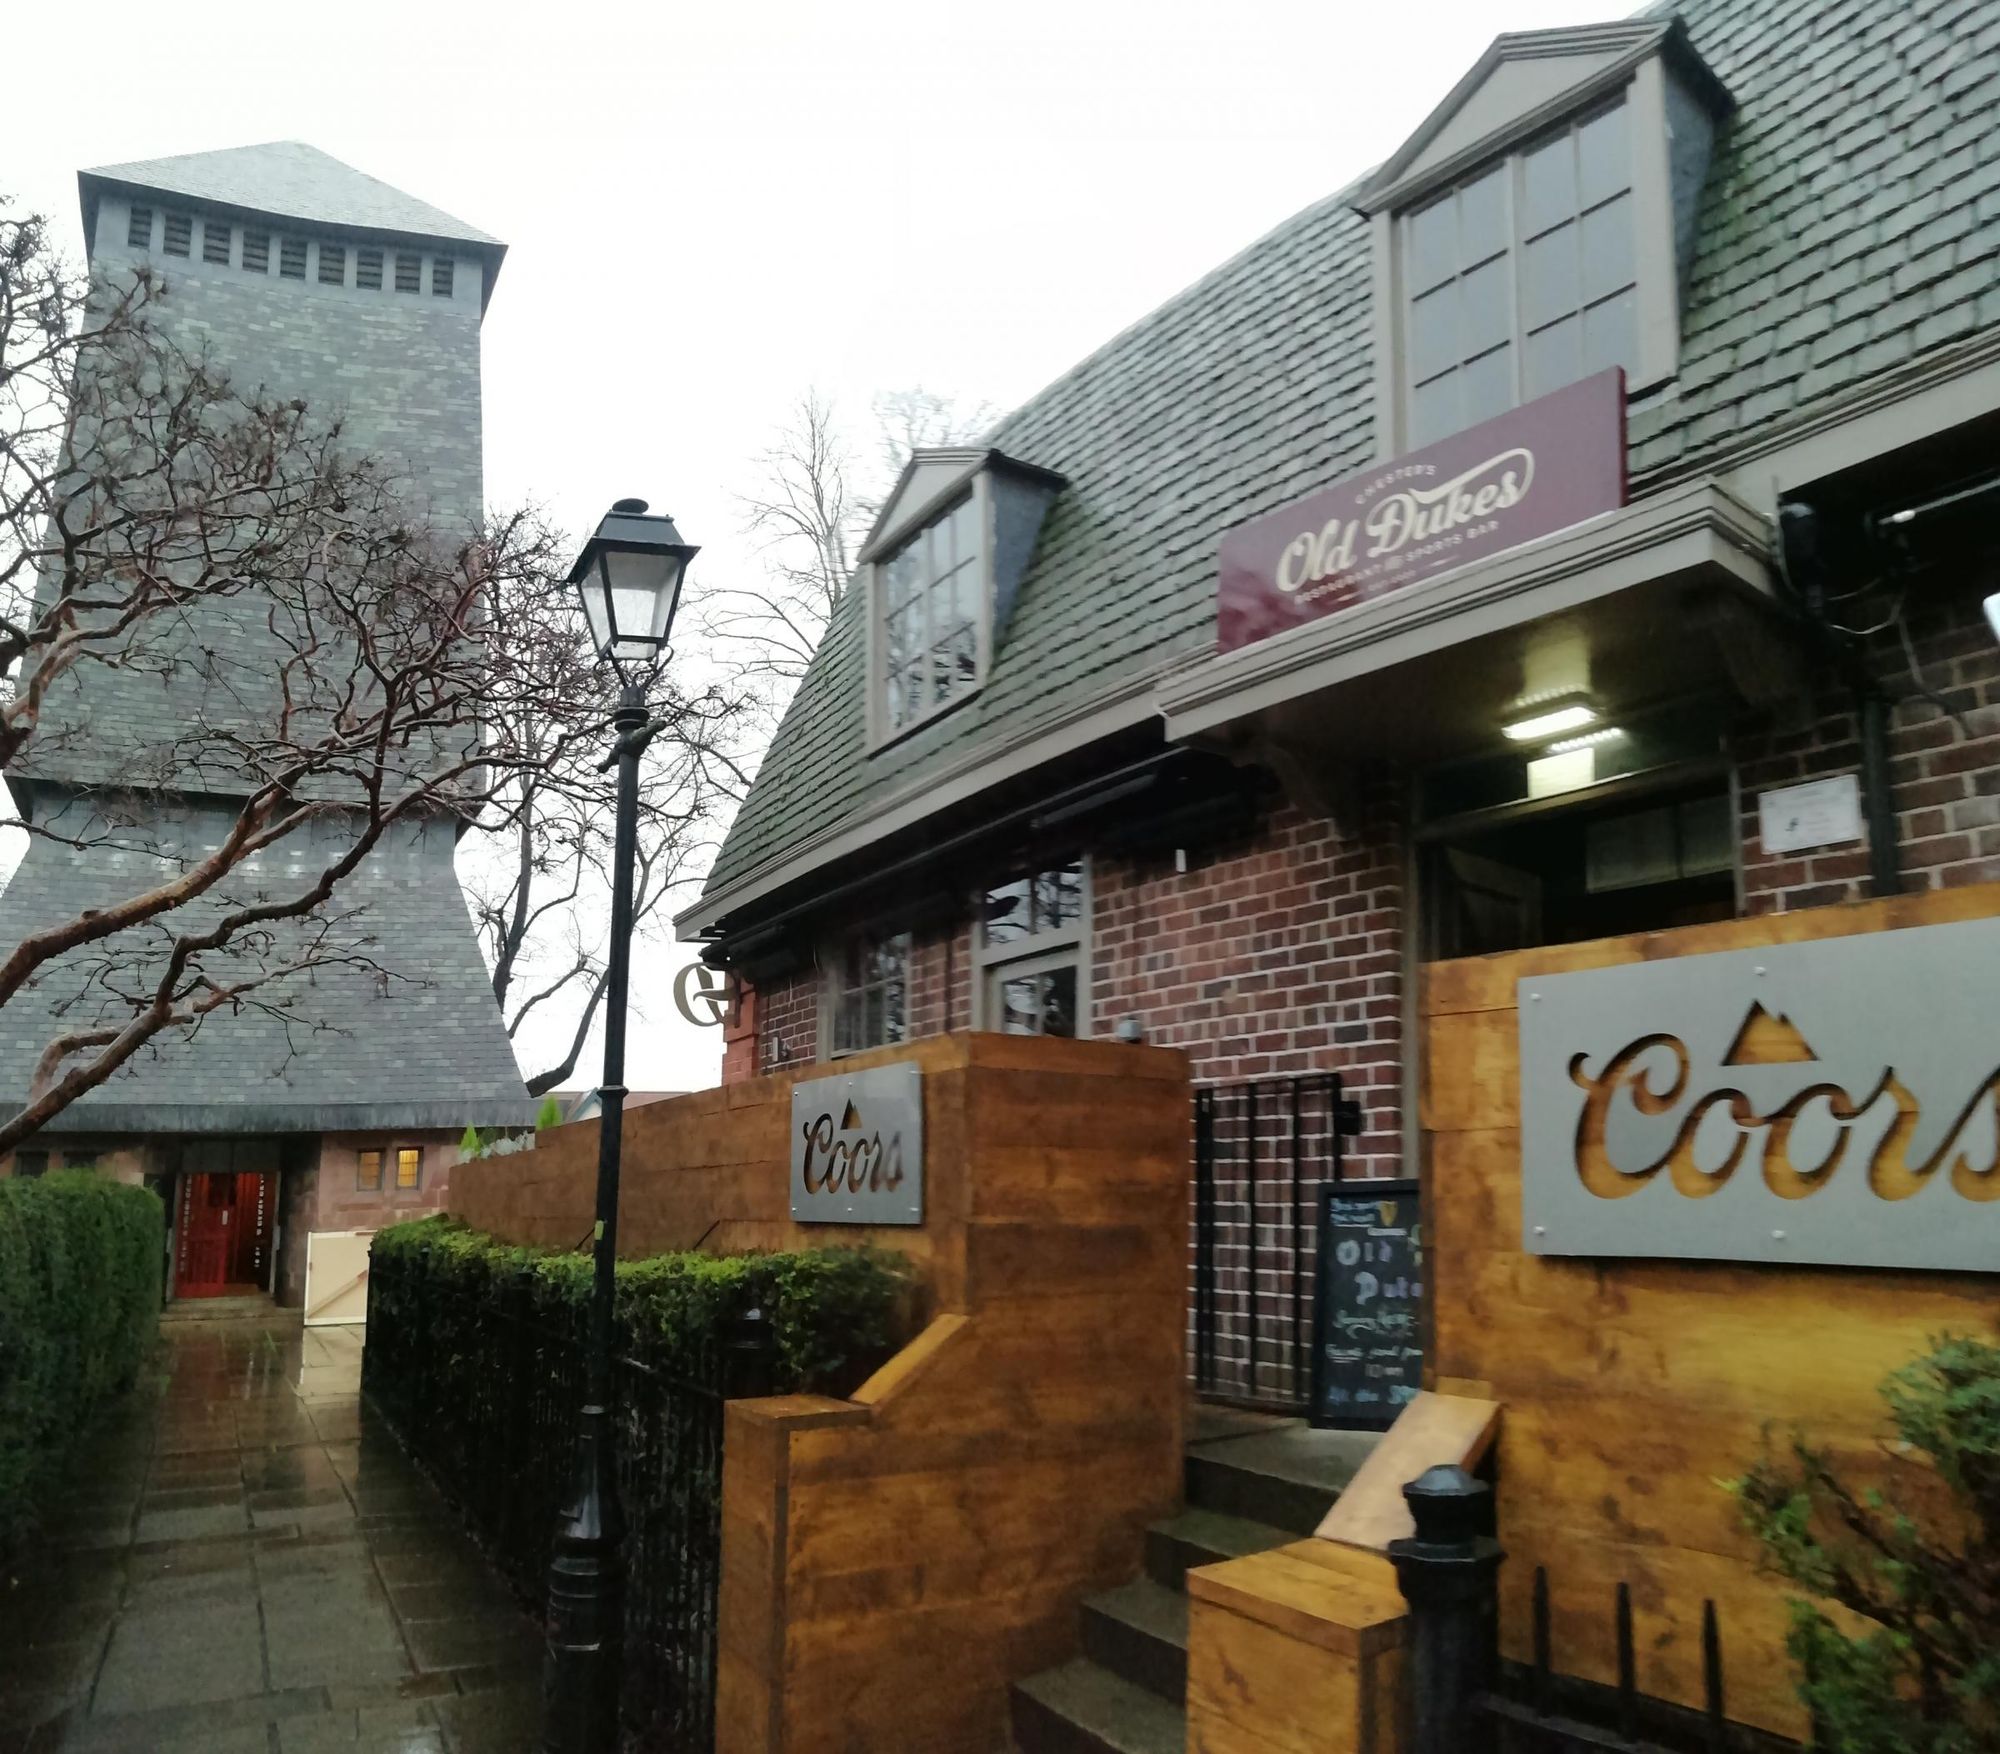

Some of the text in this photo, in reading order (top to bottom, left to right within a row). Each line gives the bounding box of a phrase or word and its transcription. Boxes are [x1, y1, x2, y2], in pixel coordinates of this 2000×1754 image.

[1275, 447, 1536, 592] Old Dukes
[1354, 463, 1438, 505] CHESTER'S
[1405, 533, 1463, 563] SPORTS
[1466, 519, 1499, 540] BAR
[802, 1112, 904, 1195] Coors
[1568, 1032, 2000, 1202] Coors
